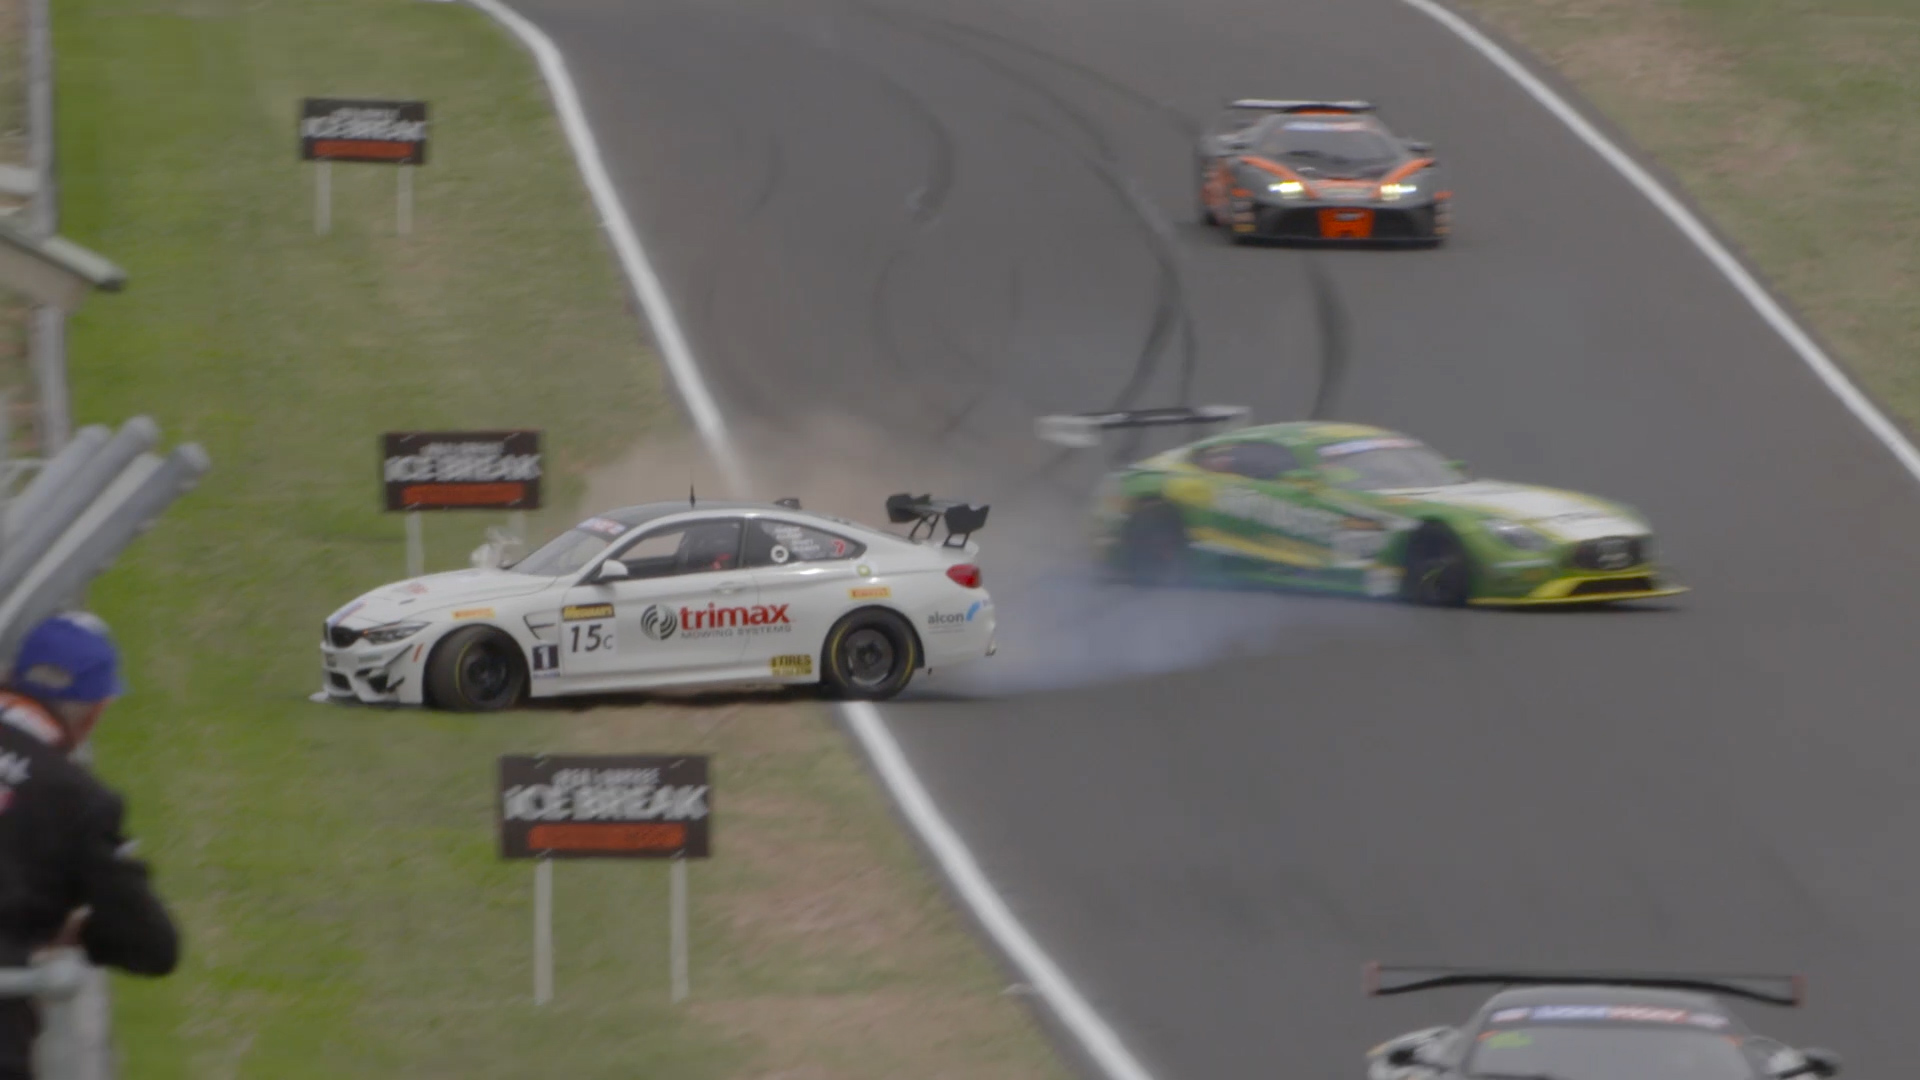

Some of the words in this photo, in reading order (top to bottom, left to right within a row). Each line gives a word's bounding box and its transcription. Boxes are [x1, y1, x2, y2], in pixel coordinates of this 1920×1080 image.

[680, 602, 789, 631] trimax
[927, 611, 965, 624] alcon
[681, 628, 733, 639] MOWING
[737, 625, 792, 636] SYSTEMS
[573, 785, 710, 820] BREAK
